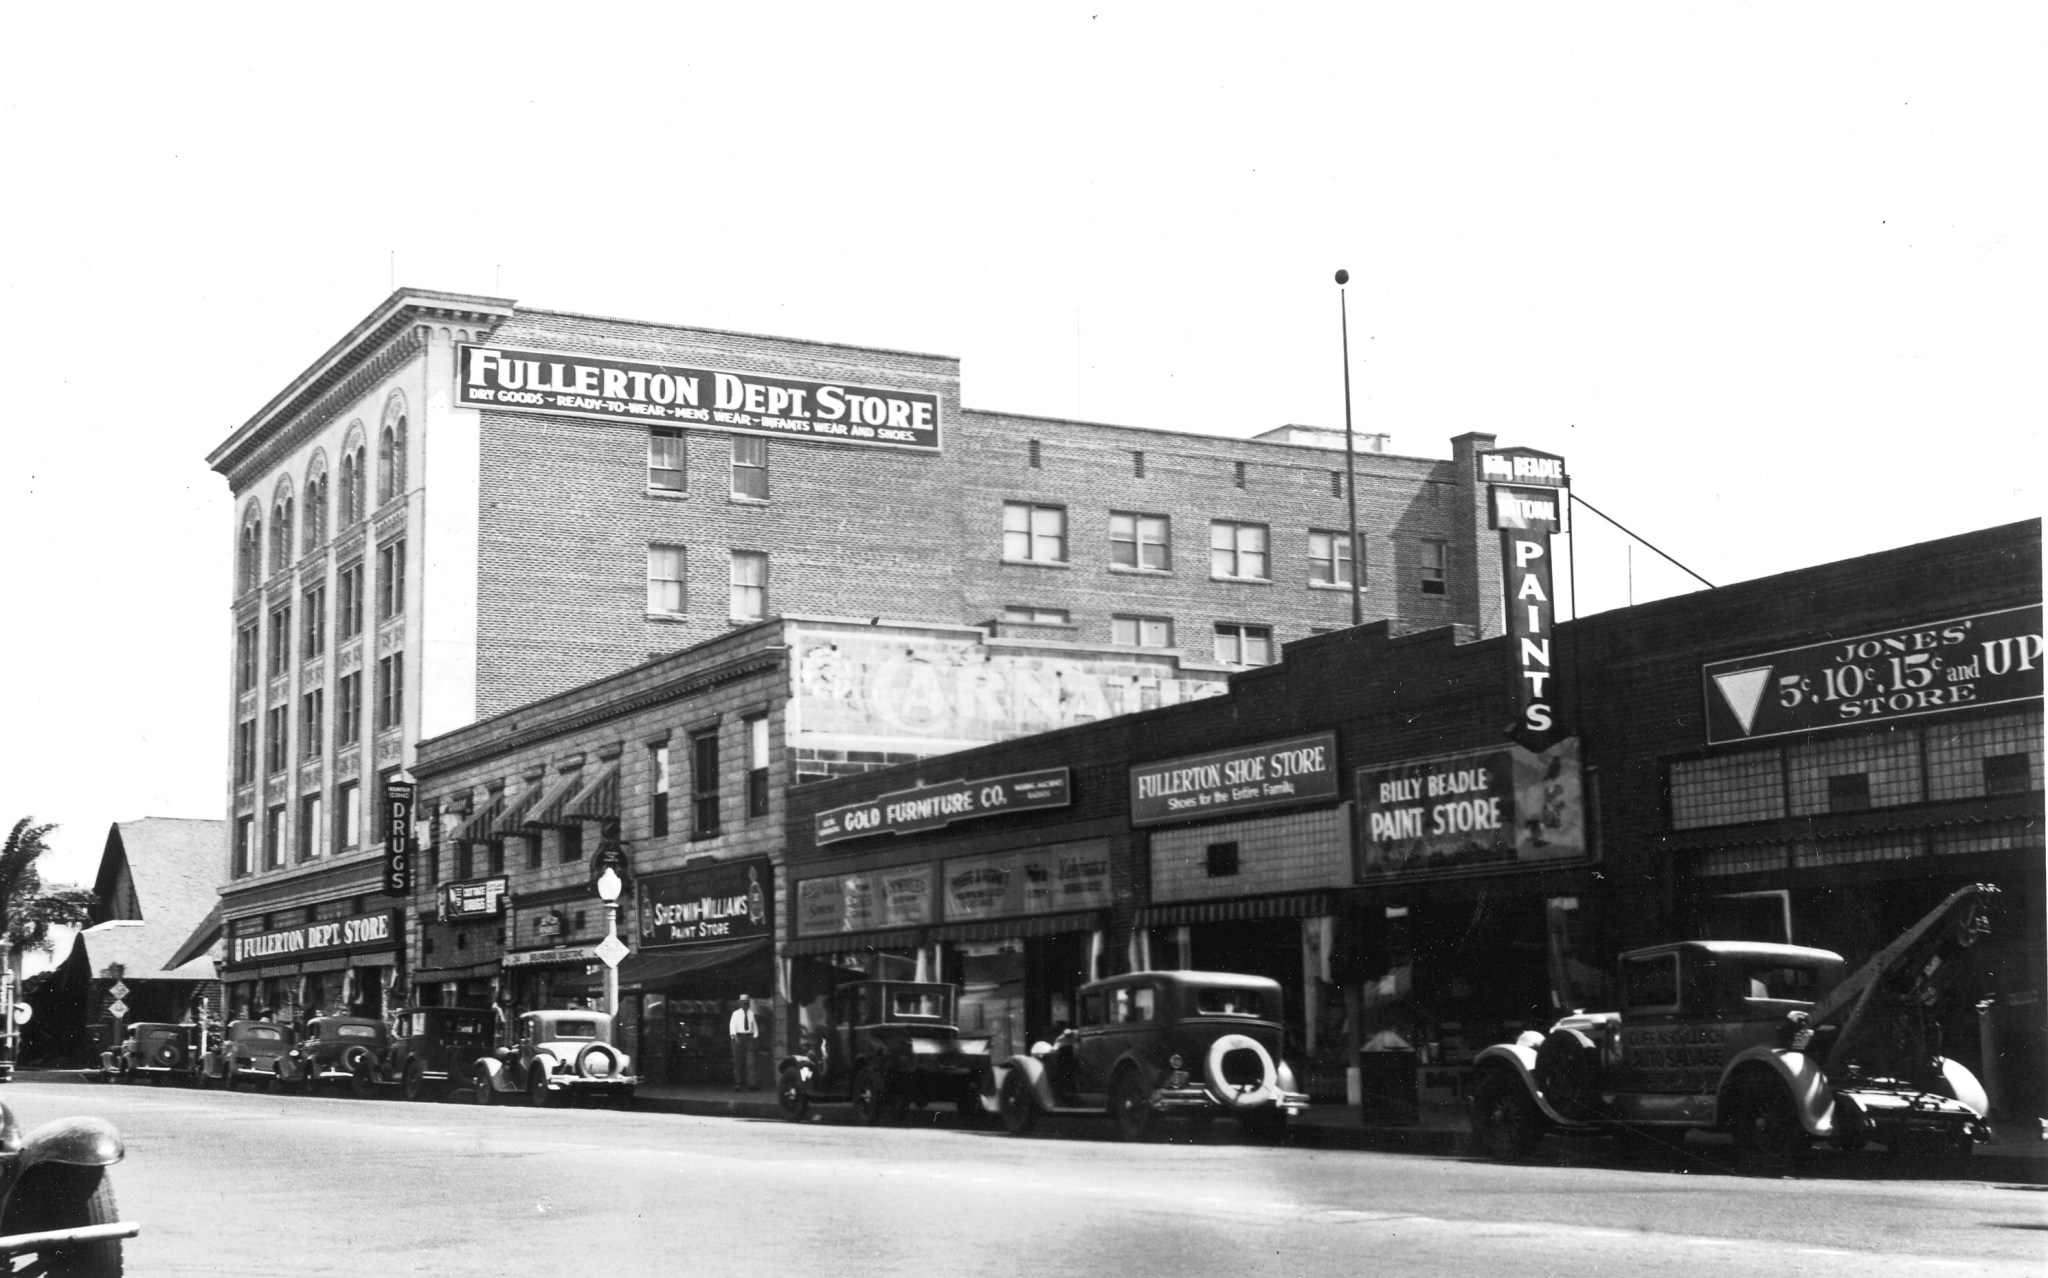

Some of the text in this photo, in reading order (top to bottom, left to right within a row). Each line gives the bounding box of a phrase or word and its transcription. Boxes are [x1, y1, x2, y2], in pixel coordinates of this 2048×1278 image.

[468, 348, 934, 430] FULLERTON DEPT. STORE
[469, 387, 496, 400] DRY
[498, 389, 544, 405] GOODS
[713, 411, 752, 425] WEAR
[813, 421, 848, 435] WEAR
[851, 425, 875, 438] AND
[1513, 456, 1562, 478] BEADLE
[1515, 540, 1552, 731] PAINTS
[1946, 655, 1981, 682] and
[1981, 634, 2043, 675] UP
[1839, 683, 1976, 718] STORE
[1138, 746, 1326, 799] FULLERTON SHOE STORE
[1380, 768, 1488, 803] BILLY BEADLE
[844, 807, 881, 831] GOLD
[886, 791, 974, 824] FURNITURE
[1167, 797, 1197, 810] Shoes
[1199, 793, 1212, 805] for
[1213, 791, 1229, 803] the
[1232, 786, 1260, 800] Entire
[1370, 797, 1502, 842] PAINT STORE
[392, 802, 405, 888] DRUGS
[654, 895, 748, 926] SHERWIN-WILLIAMS
[671, 922, 730, 939] PAINT STORE
[244, 930, 305, 958] FULLERTON
[344, 915, 389, 944] STORE
